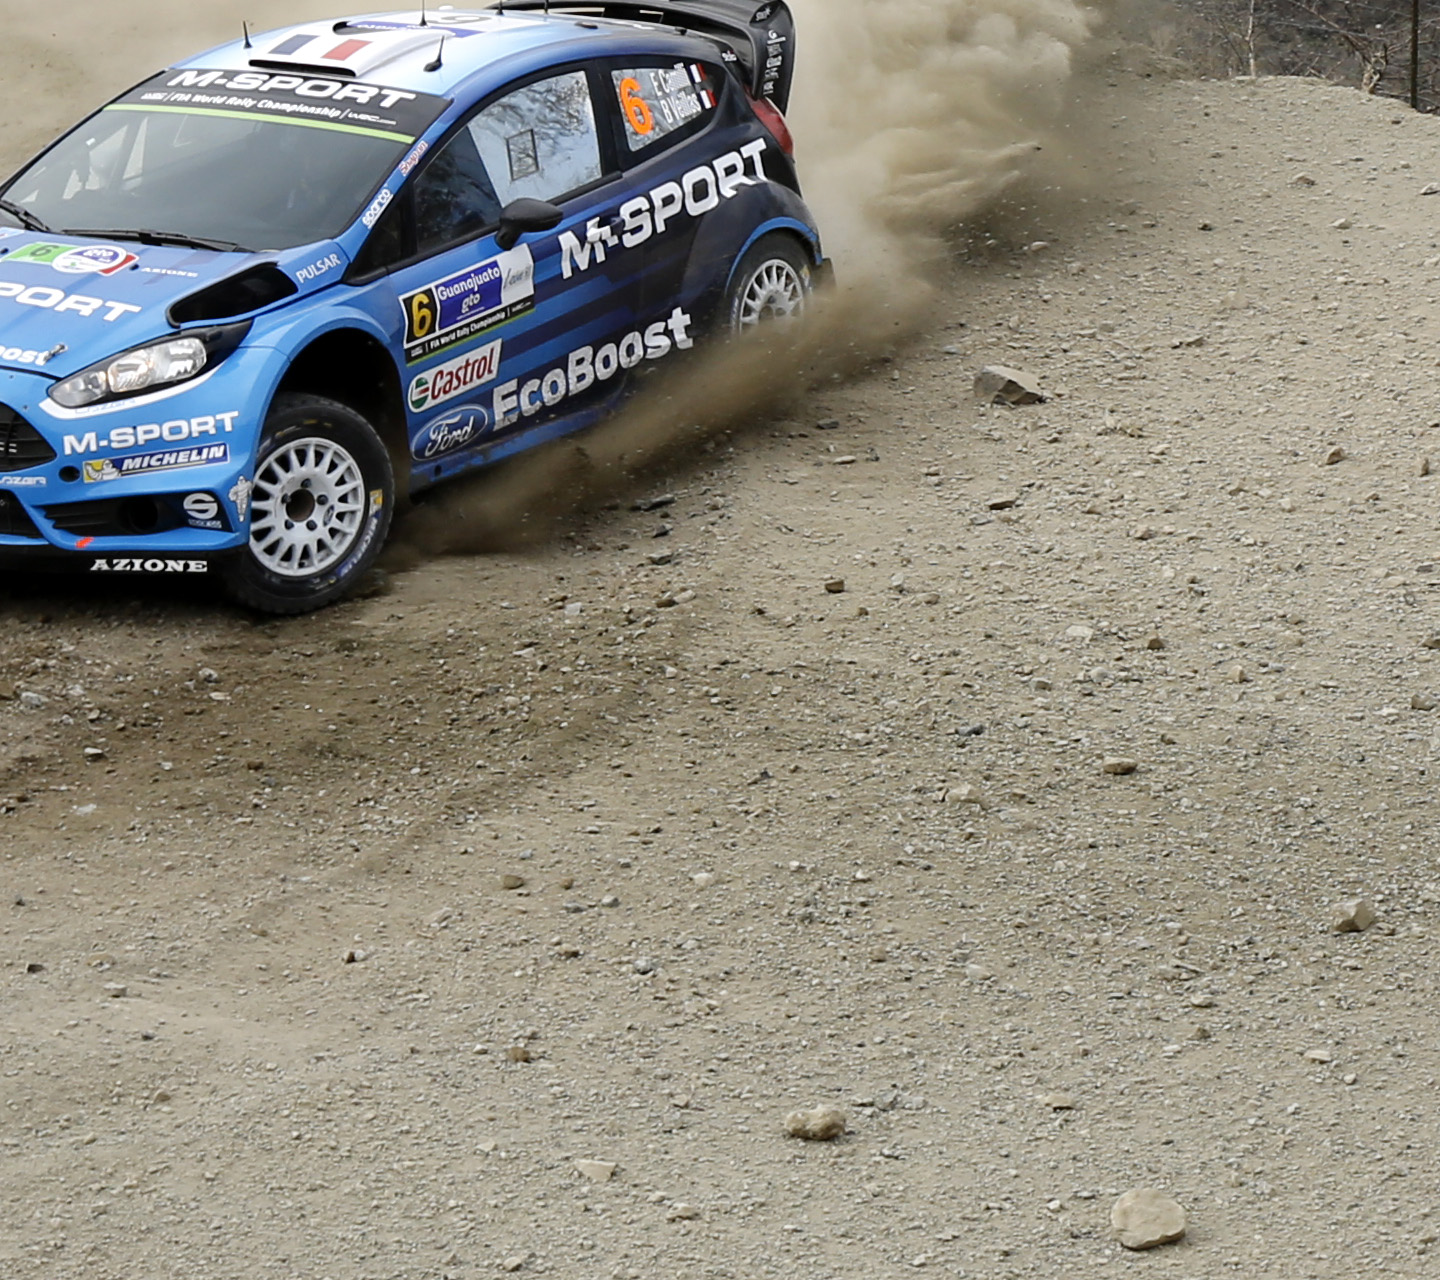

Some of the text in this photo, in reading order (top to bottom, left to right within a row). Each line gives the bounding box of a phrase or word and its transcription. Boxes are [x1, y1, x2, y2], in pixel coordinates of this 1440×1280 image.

[166, 70, 416, 108] M-SPORT
[170, 93, 192, 102] FIA
[192, 94, 227, 105] World
[225, 96, 257, 108] Rally
[257, 99, 342, 118] Championship
[619, 77, 654, 135] 6
[557, 138, 768, 279] M-SPORT
[30, 244, 60, 256] 6
[295, 253, 341, 284] PULSAR
[437, 266, 501, 301] Guanajuato
[462, 292, 480, 313] gto
[412, 292, 432, 338] 6
[430, 347, 495, 400] Castrol
[493, 306, 694, 431] EcoBoost
[63, 411, 239, 456] M-SPORT
[424, 413, 475, 457] Ford
[121, 444, 226, 471] MICHELIN
[89, 558, 208, 573] AZIONE
